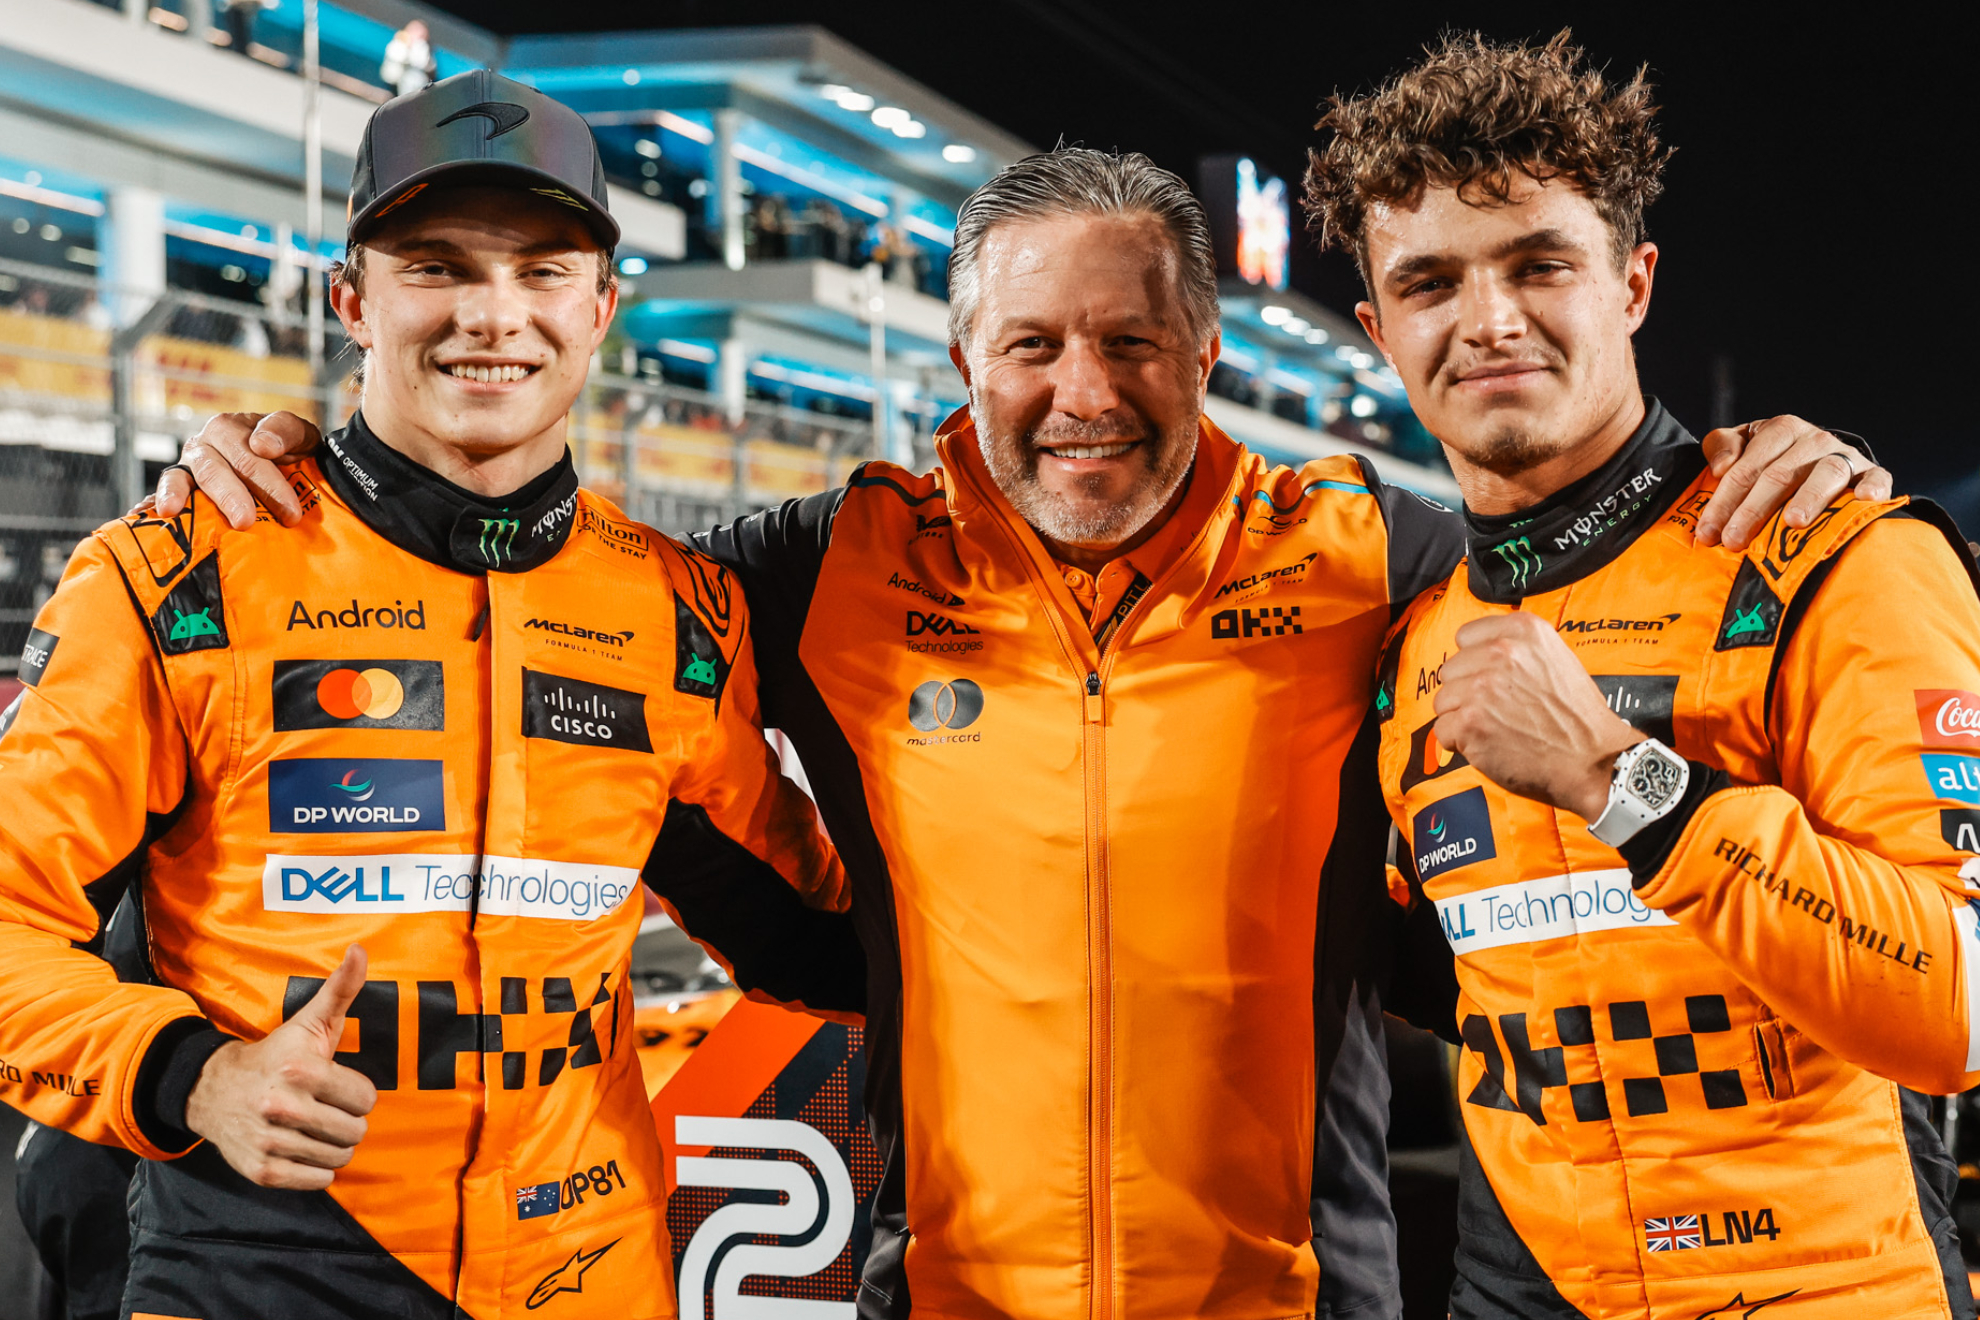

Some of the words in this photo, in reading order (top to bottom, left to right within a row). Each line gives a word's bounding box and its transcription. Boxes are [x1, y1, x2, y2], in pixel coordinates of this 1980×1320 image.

[342, 456, 379, 491] OPTIMUM
[531, 489, 578, 538] MONST
[1554, 467, 1662, 550] MONSTER
[1583, 494, 1652, 547] ENERGY
[598, 534, 616, 550] THE
[620, 546, 647, 560] STAY
[887, 572, 947, 605] Android
[1214, 563, 1306, 600] McLaren
[286, 599, 426, 631] Android
[523, 618, 624, 647] McLaren
[1556, 619, 1664, 633] McLaren
[545, 638, 588, 653] FORMULA
[601, 651, 623, 662] TEAM
[906, 640, 983, 655] Technologies
[1576, 638, 1618, 648] FORMULA
[907, 732, 982, 746] mastercard
[294, 807, 327, 823] DP
[331, 806, 420, 823] WORLD
[1418, 856, 1430, 873] DP
[1429, 838, 1477, 866] WORLD
[281, 866, 405, 904] DELL
[1481, 880, 1651, 922] Technolog
[1713, 837, 1836, 925] RICHARD
[1839, 917, 1933, 975] MILLE
[561, 1160, 626, 1210] OP81
[1700, 1208, 1780, 1247] LN4
